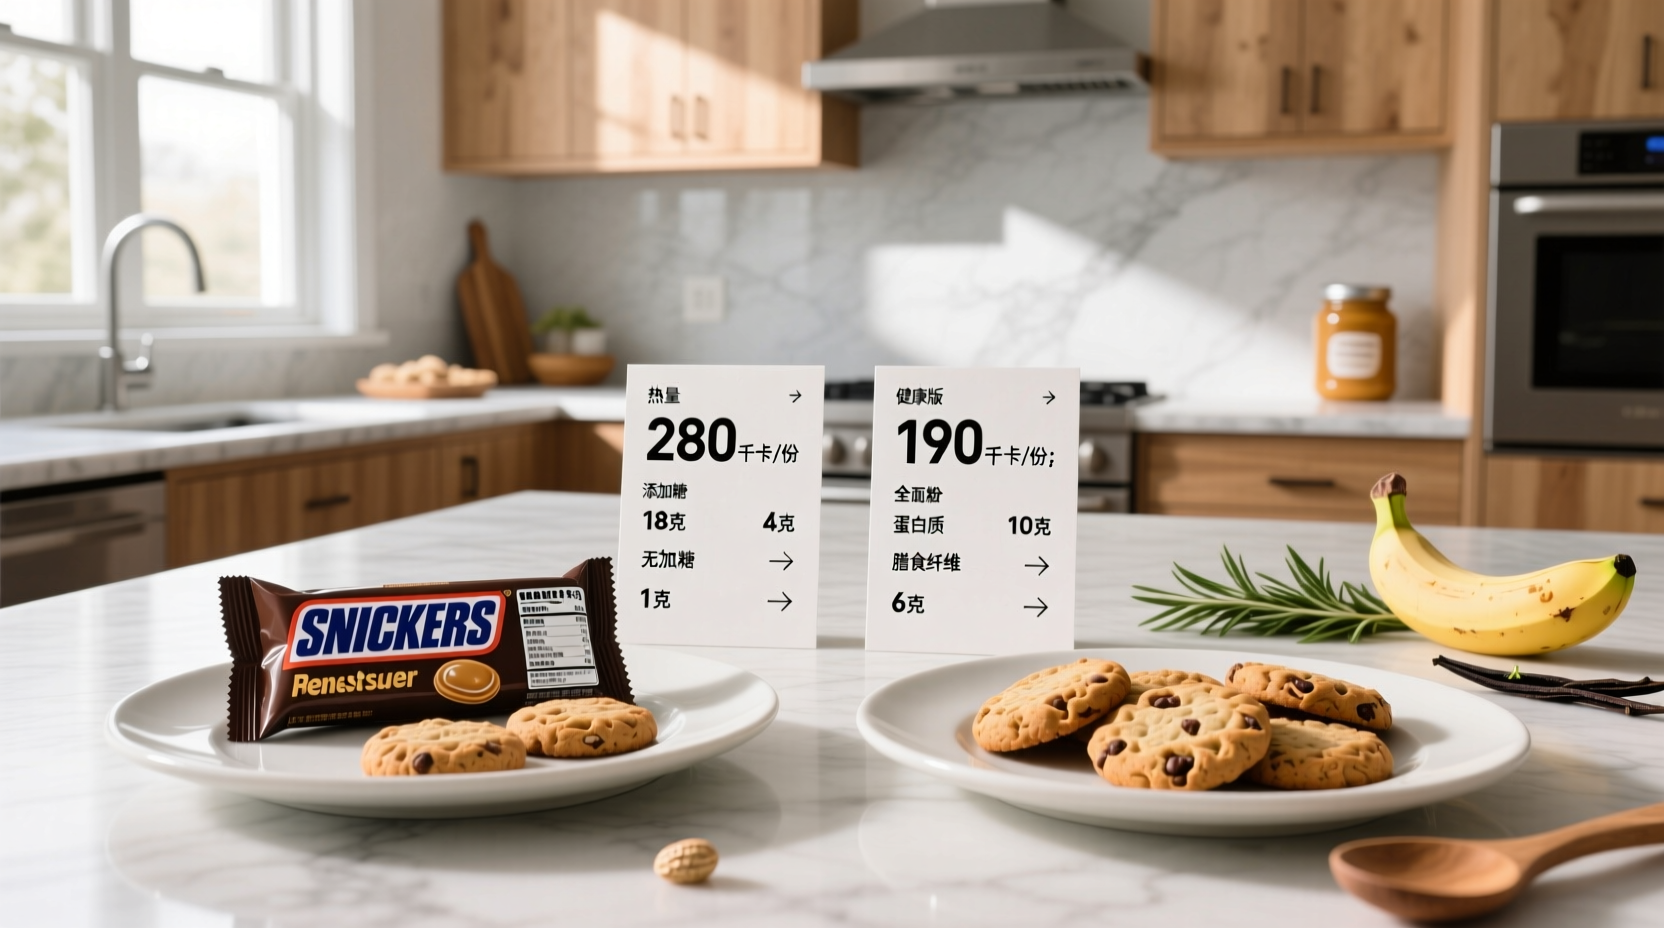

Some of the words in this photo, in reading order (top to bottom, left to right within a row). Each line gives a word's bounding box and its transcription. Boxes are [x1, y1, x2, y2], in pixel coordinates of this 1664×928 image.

[647, 386, 681, 404] 热量
[895, 387, 944, 406] 健康版
[642, 482, 688, 500] 添加糖
[643, 510, 686, 532] 18克
[762, 511, 795, 533] 4克
[893, 514, 945, 535] 蛋白质
[1008, 515, 1052, 537] 10克
[641, 548, 695, 570] 无加糖
[640, 587, 671, 609] 1克
[891, 591, 925, 614] 6克
[296, 600, 497, 657] SNICKERS
